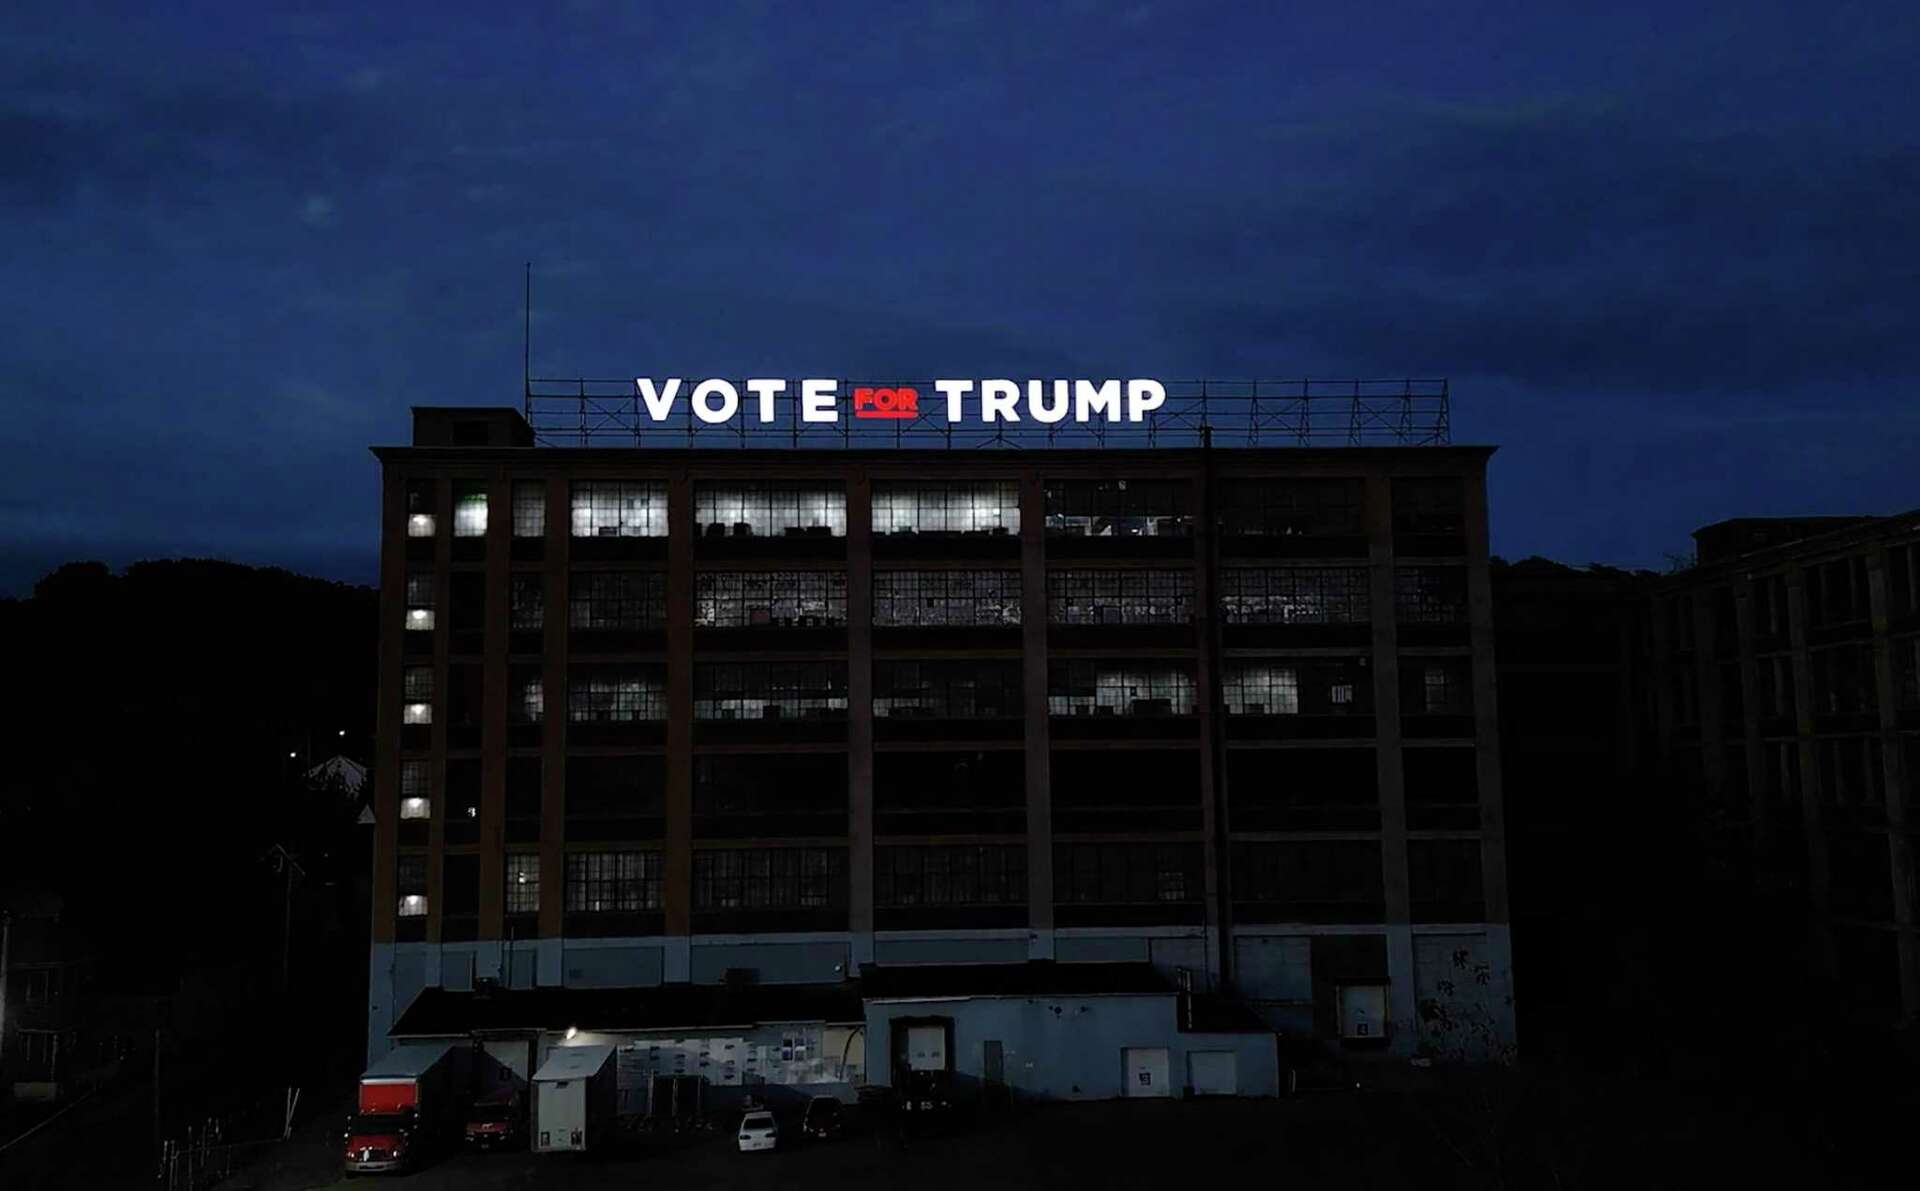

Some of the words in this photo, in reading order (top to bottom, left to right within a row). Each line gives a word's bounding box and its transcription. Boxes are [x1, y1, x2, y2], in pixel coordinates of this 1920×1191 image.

[636, 378, 839, 423] VOTE
[854, 388, 918, 411] FOR
[935, 379, 1166, 423] TRUMP
